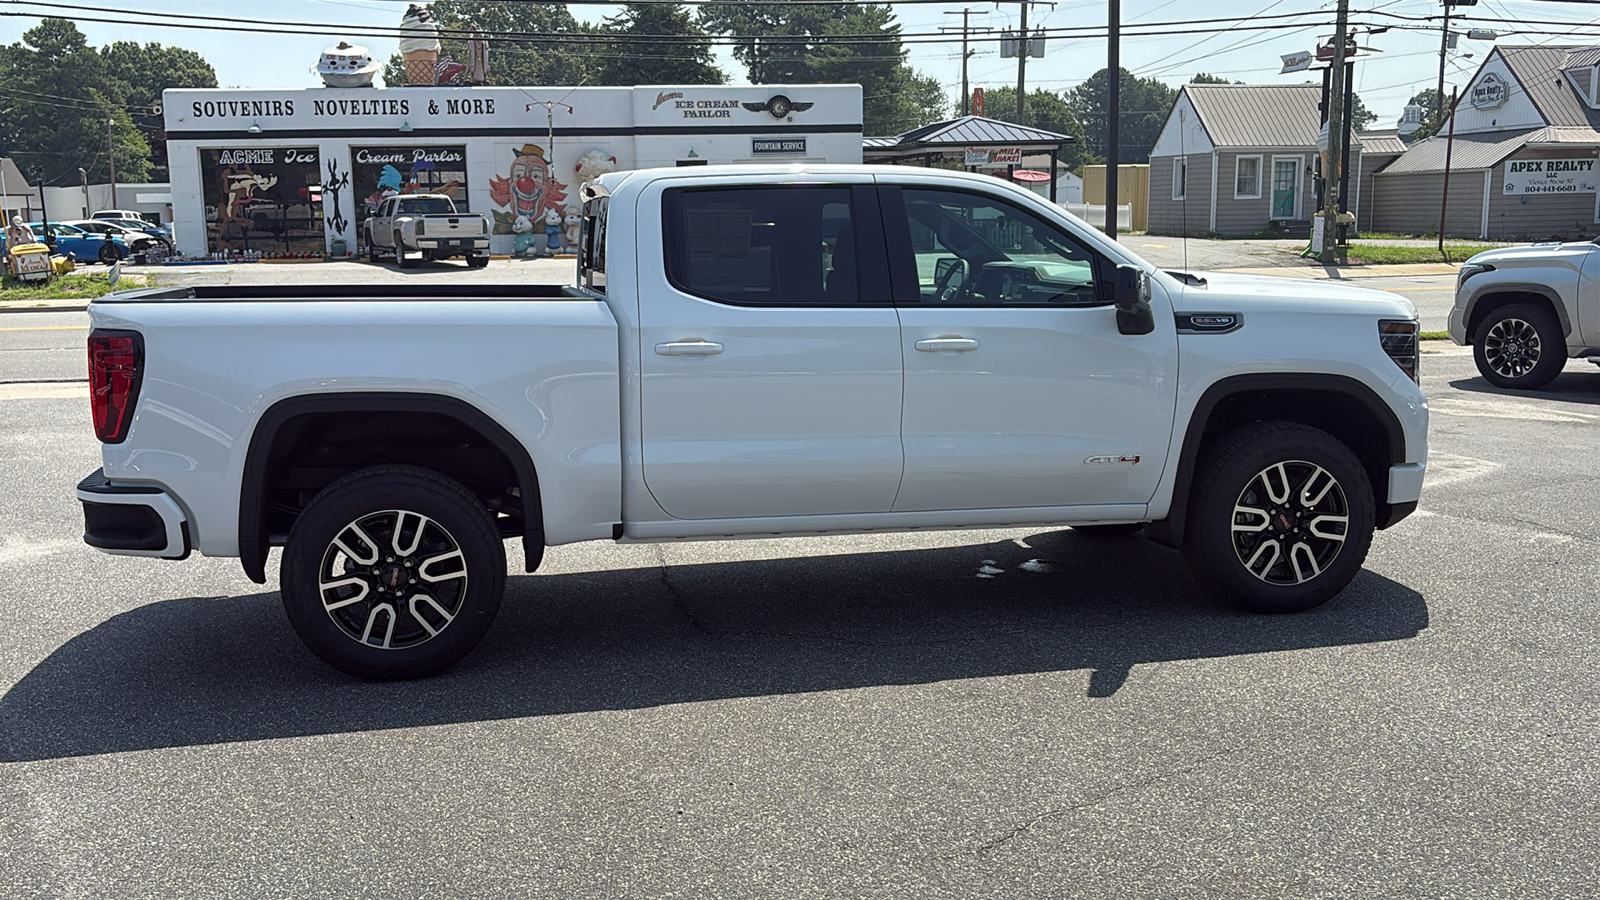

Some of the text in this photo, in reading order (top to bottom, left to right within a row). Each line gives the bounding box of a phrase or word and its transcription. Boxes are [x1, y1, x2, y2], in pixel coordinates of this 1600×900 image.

[192, 99, 495, 117] SOUVENIRS NOVELTIES & MORE
[675, 100, 739, 109] ICE CREAM
[683, 110, 731, 118] PARLOR
[754, 142, 804, 151] FOUNTAIN SERVICE
[219, 149, 316, 165] ACME Ice
[356, 149, 464, 164] Cream Parlor
[1510, 160, 1594, 172] APEX REALTY
[1525, 185, 1577, 193] 804-443-6683
[1084, 454, 1141, 465] AT4
